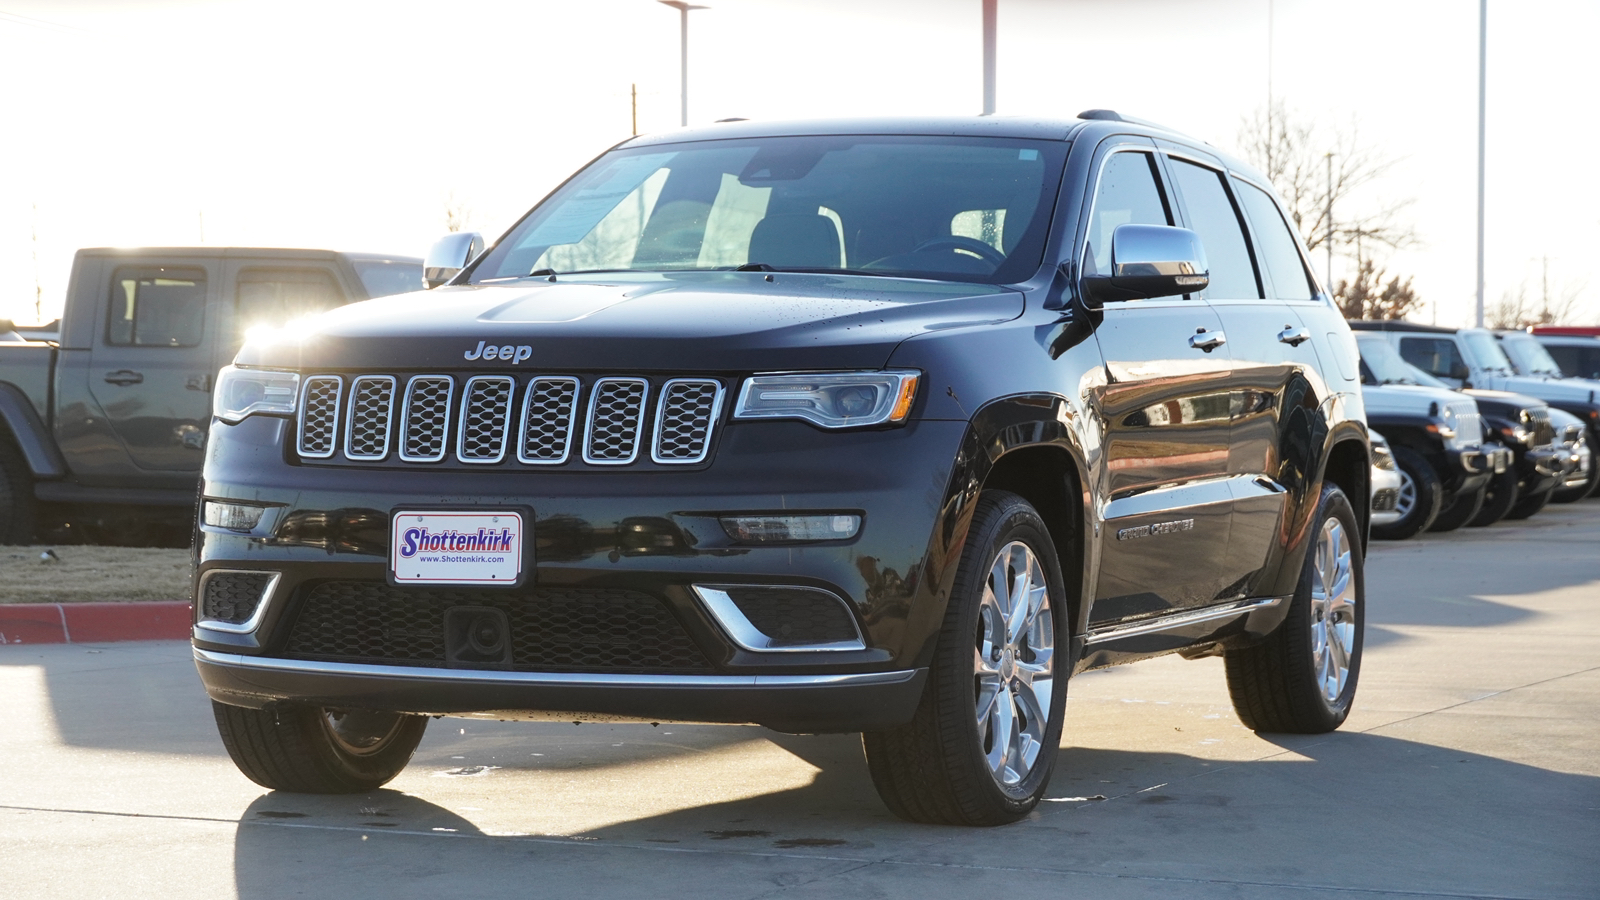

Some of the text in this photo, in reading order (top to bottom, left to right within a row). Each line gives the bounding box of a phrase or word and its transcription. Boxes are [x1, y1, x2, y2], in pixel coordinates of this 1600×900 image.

[464, 340, 533, 365] Jeep
[401, 527, 514, 557] Shottenkirk
[419, 555, 505, 563] www.Shottenkirk.com
